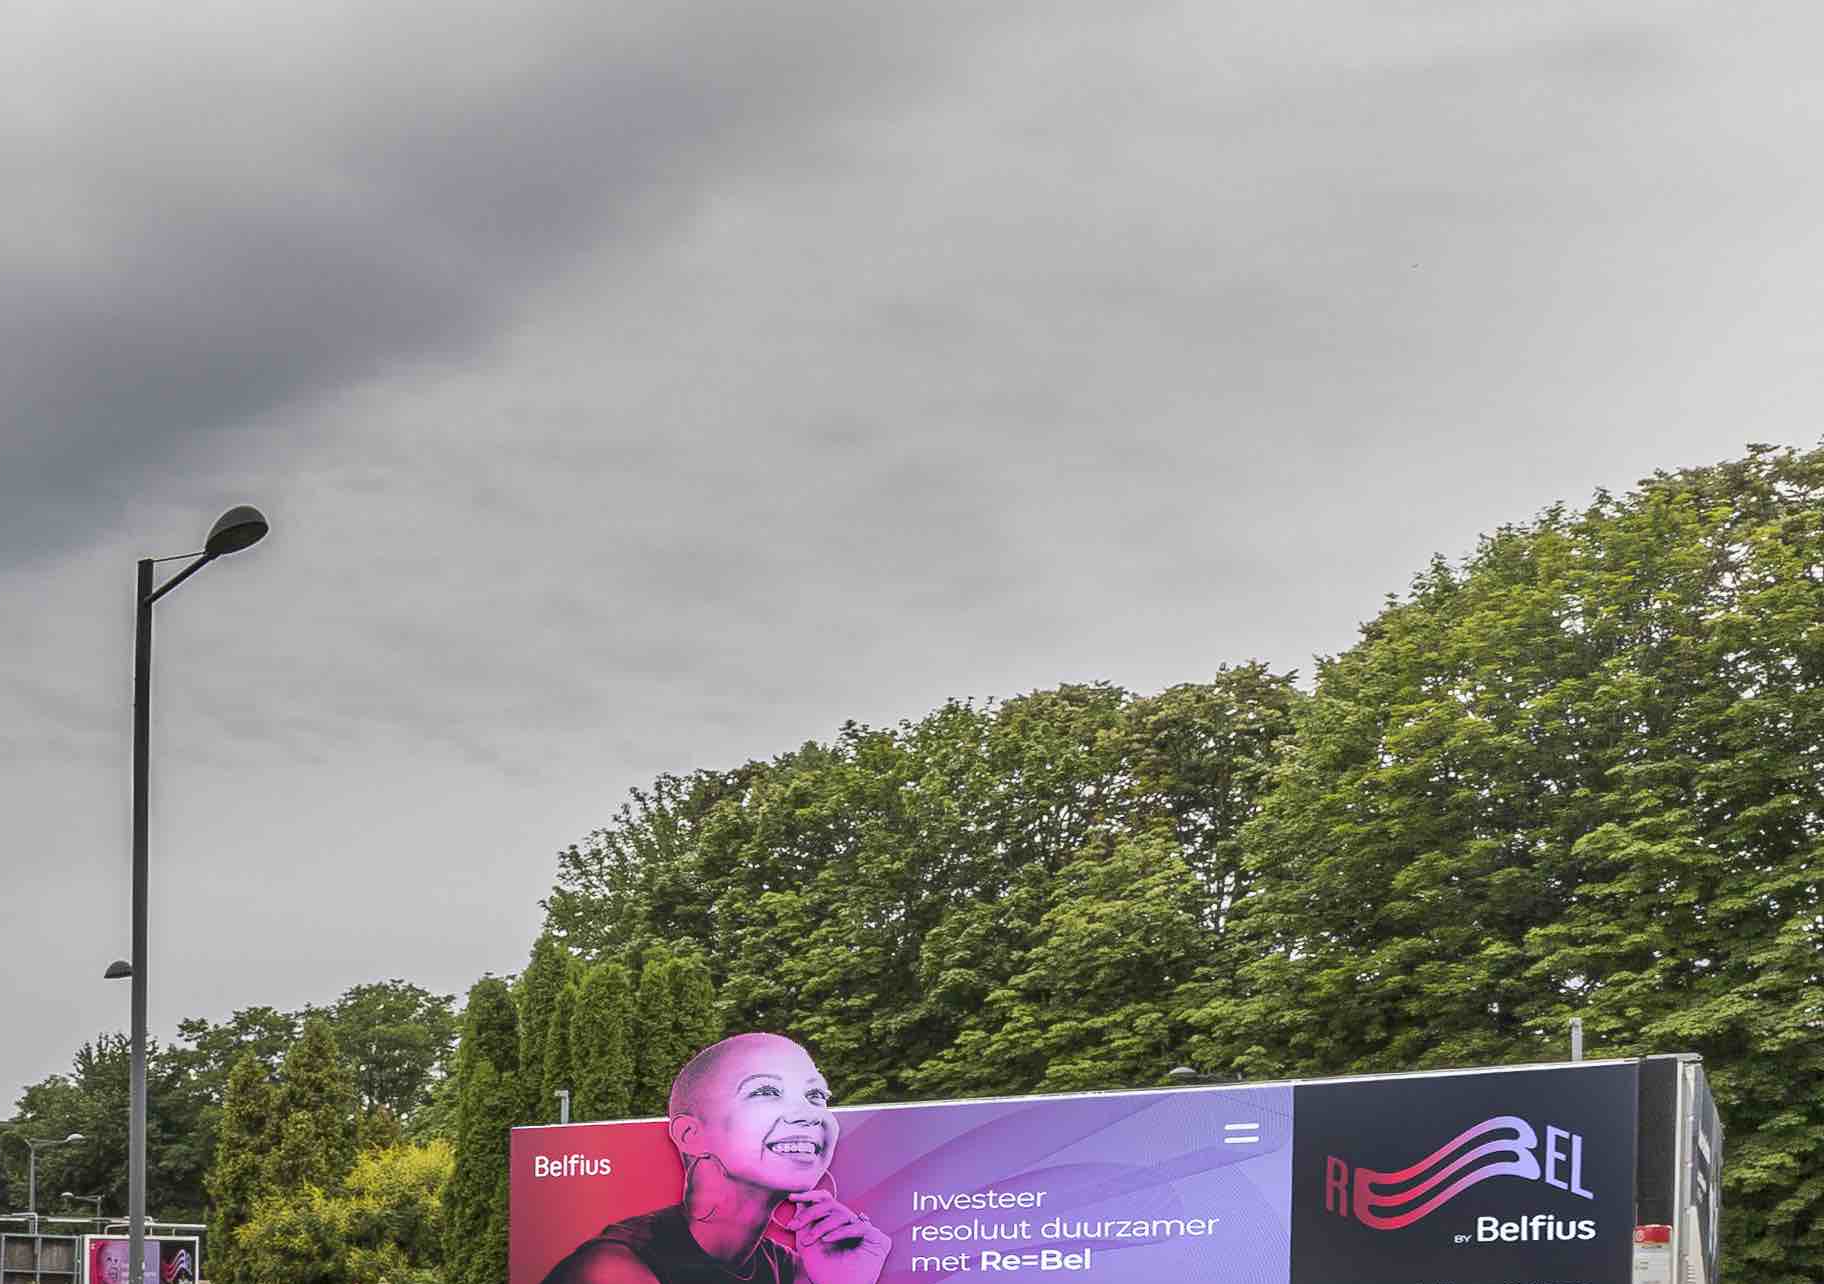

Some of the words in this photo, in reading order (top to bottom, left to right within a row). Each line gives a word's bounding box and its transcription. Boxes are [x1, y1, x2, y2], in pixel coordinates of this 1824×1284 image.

[534, 1153, 612, 1178] Belfius
[912, 1189, 1047, 1211] Investeer
[912, 1218, 1032, 1241] resoluut
[1040, 1216, 1220, 1239] duurzamer
[1454, 1234, 1472, 1243] BY
[1476, 1214, 1597, 1242] Belfius
[911, 1252, 971, 1272] met
[981, 1248, 1091, 1271] Re=Bel
